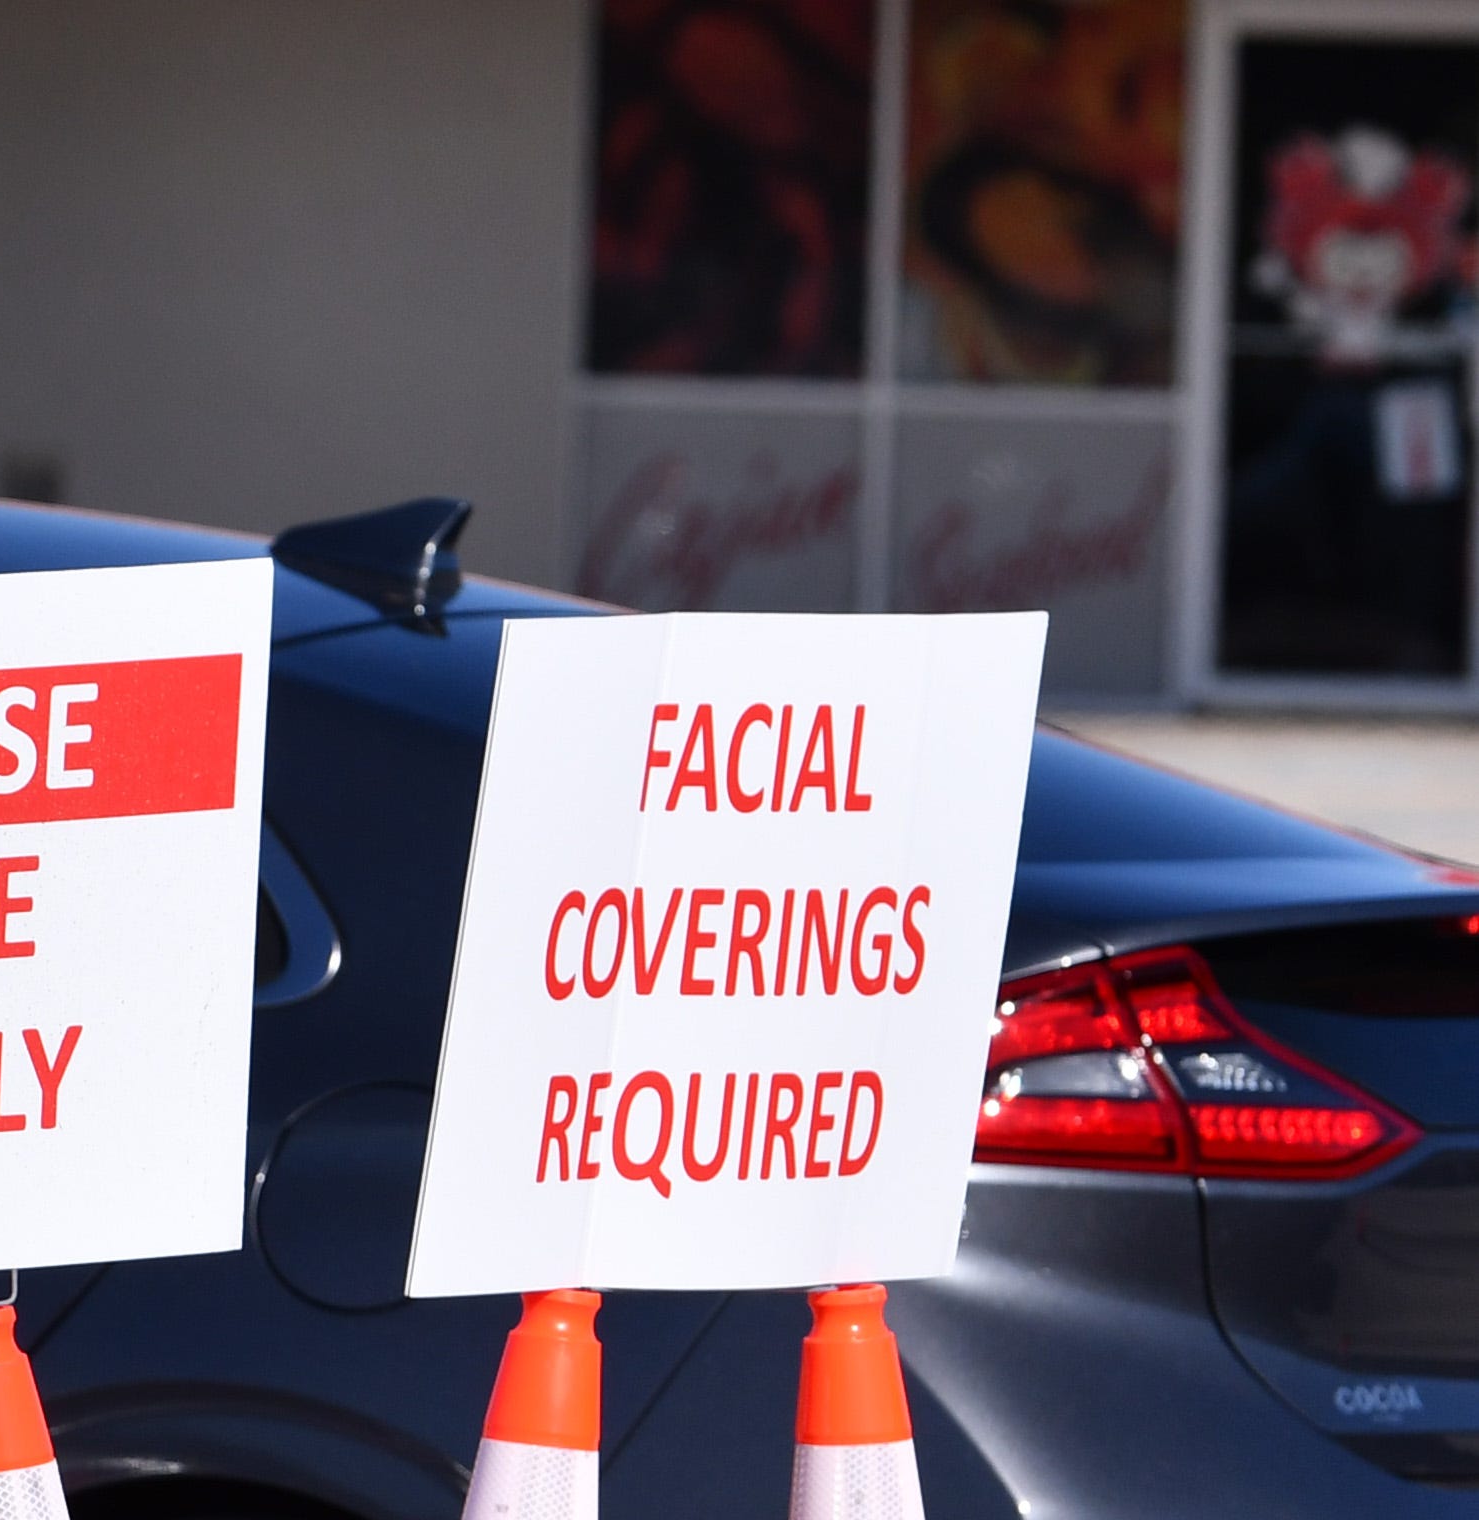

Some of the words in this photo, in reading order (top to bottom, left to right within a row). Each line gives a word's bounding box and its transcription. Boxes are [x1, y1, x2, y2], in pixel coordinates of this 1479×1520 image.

[639, 702, 873, 814] FACIAL
[544, 884, 932, 1002] COVERINGS
[535, 1069, 884, 1200] REQUIRED
